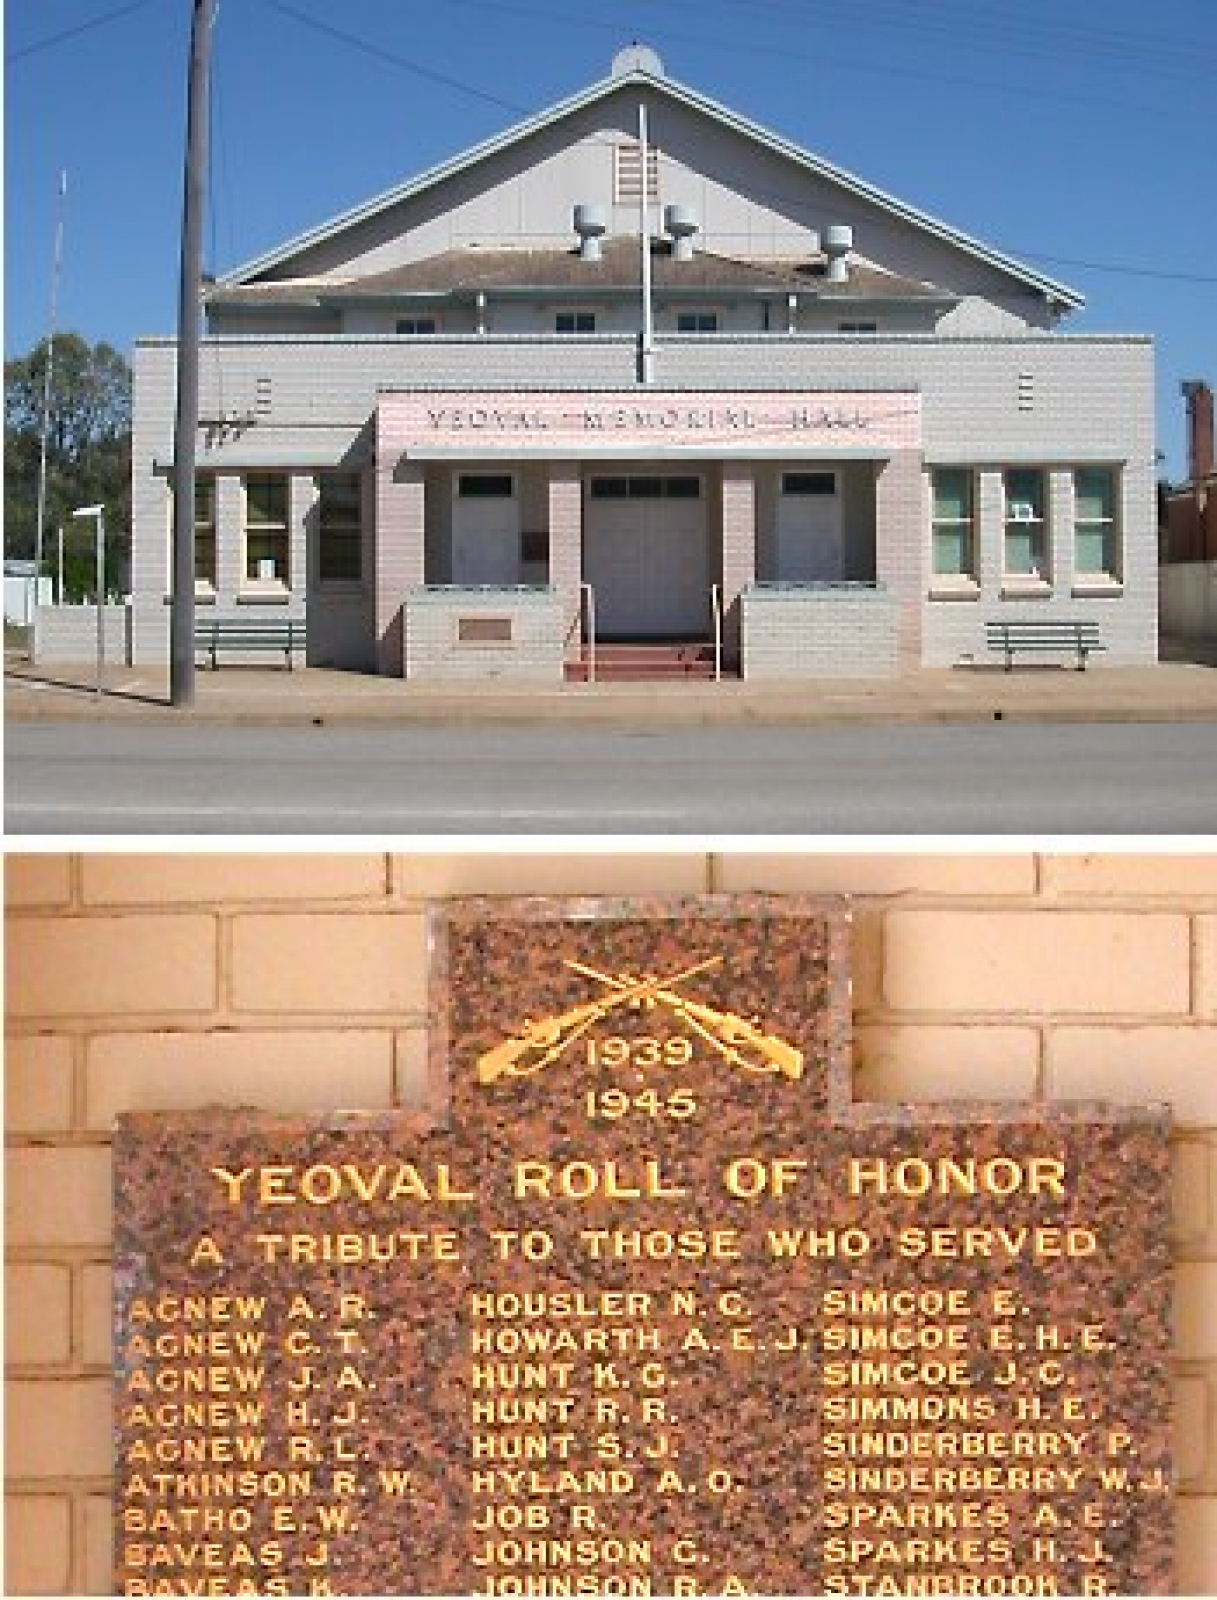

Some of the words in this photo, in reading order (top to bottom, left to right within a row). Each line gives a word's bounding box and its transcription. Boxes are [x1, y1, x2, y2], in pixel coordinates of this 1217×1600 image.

[427, 409, 547, 429] YEOVAL
[582, 409, 756, 429] MEMORIAL
[586, 1036, 692, 1065] 1939
[586, 1088, 696, 1117] 1945
[211, 1164, 474, 1204] YEOVAL
[514, 1160, 686, 1198] ROLL
[723, 1158, 807, 1197] OF
[848, 1158, 1067, 1196] HONOR
[190, 1237, 223, 1266] A
[256, 1232, 460, 1264] TRIBUTE
[491, 1230, 554, 1260] TO
[581, 1229, 741, 1258] THOSE
[767, 1229, 870, 1257] WHO
[899, 1227, 1097, 1257] SERVED
[472, 1293, 651, 1316] HOUSLER
[823, 1290, 971, 1316] SIMCOE
[472, 1328, 658, 1352] HOWARTH
[823, 1325, 968, 1350] SIMCOE
[472, 1363, 574, 1388] HUNT
[823, 1360, 971, 1385] SIMCOE
[472, 1398, 574, 1423] HUNT
[823, 1397, 995, 1420] SIMMONS
[472, 1436, 574, 1458] HUNT
[823, 1432, 1088, 1457] SINDERBERRY
[125, 1472, 311, 1496] ATKINSON
[472, 1471, 634, 1493] HYLAND
[823, 1467, 1086, 1492] SINDERBERRY
[124, 1508, 252, 1532] BATHO
[472, 1505, 550, 1529] JOB
[823, 1502, 1009, 1528] SPARKES
[124, 1543, 283, 1566] BAVEAS
[472, 1540, 651, 1564] JOHNSON
[823, 1537, 1011, 1563] SPARKES
[472, 1575, 651, 1597] JOHNSON
